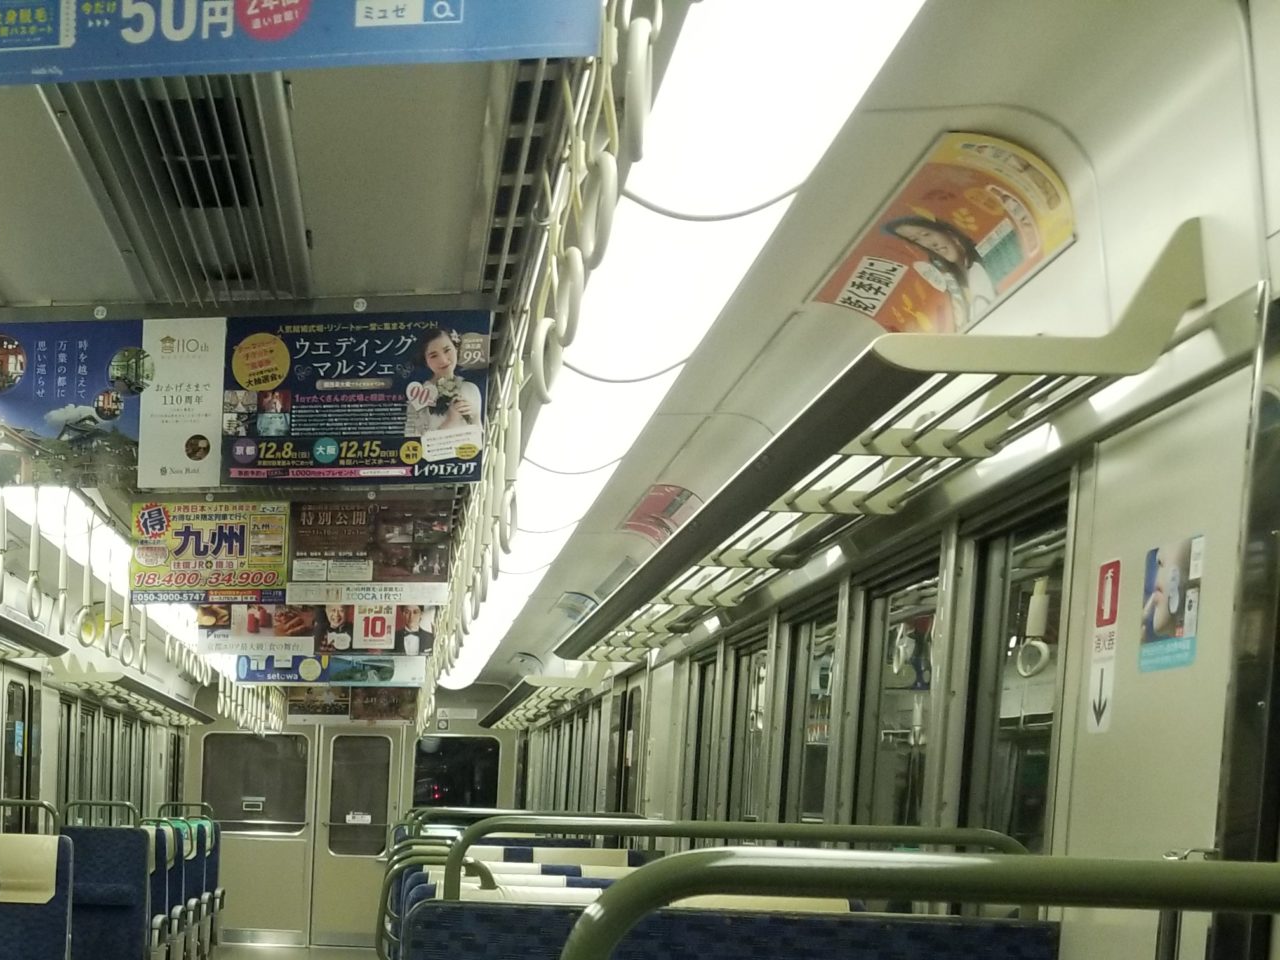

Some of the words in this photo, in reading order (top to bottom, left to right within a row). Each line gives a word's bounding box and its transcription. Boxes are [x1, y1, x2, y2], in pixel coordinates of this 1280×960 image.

[363, 5, 406, 20] ミュゼ
[35, 340, 47, 398] 思い巡らせ
[56, 340, 67, 398] 万葉の都に
[77, 339, 89, 399] 時を越えて
[312, 360, 395, 379] マルシェ
[155, 382, 211, 393] おかげさまで
[162, 395, 203, 405] 110周年
[235, 446, 256, 456] 京都
[316, 445, 337, 455] 大阪
[139, 506, 167, 536] 得
[300, 511, 367, 526] 特別公開
[171, 523, 247, 558] 九州
[137, 592, 206, 602] 050-3000-5747
[266, 672, 299, 680] setowa
